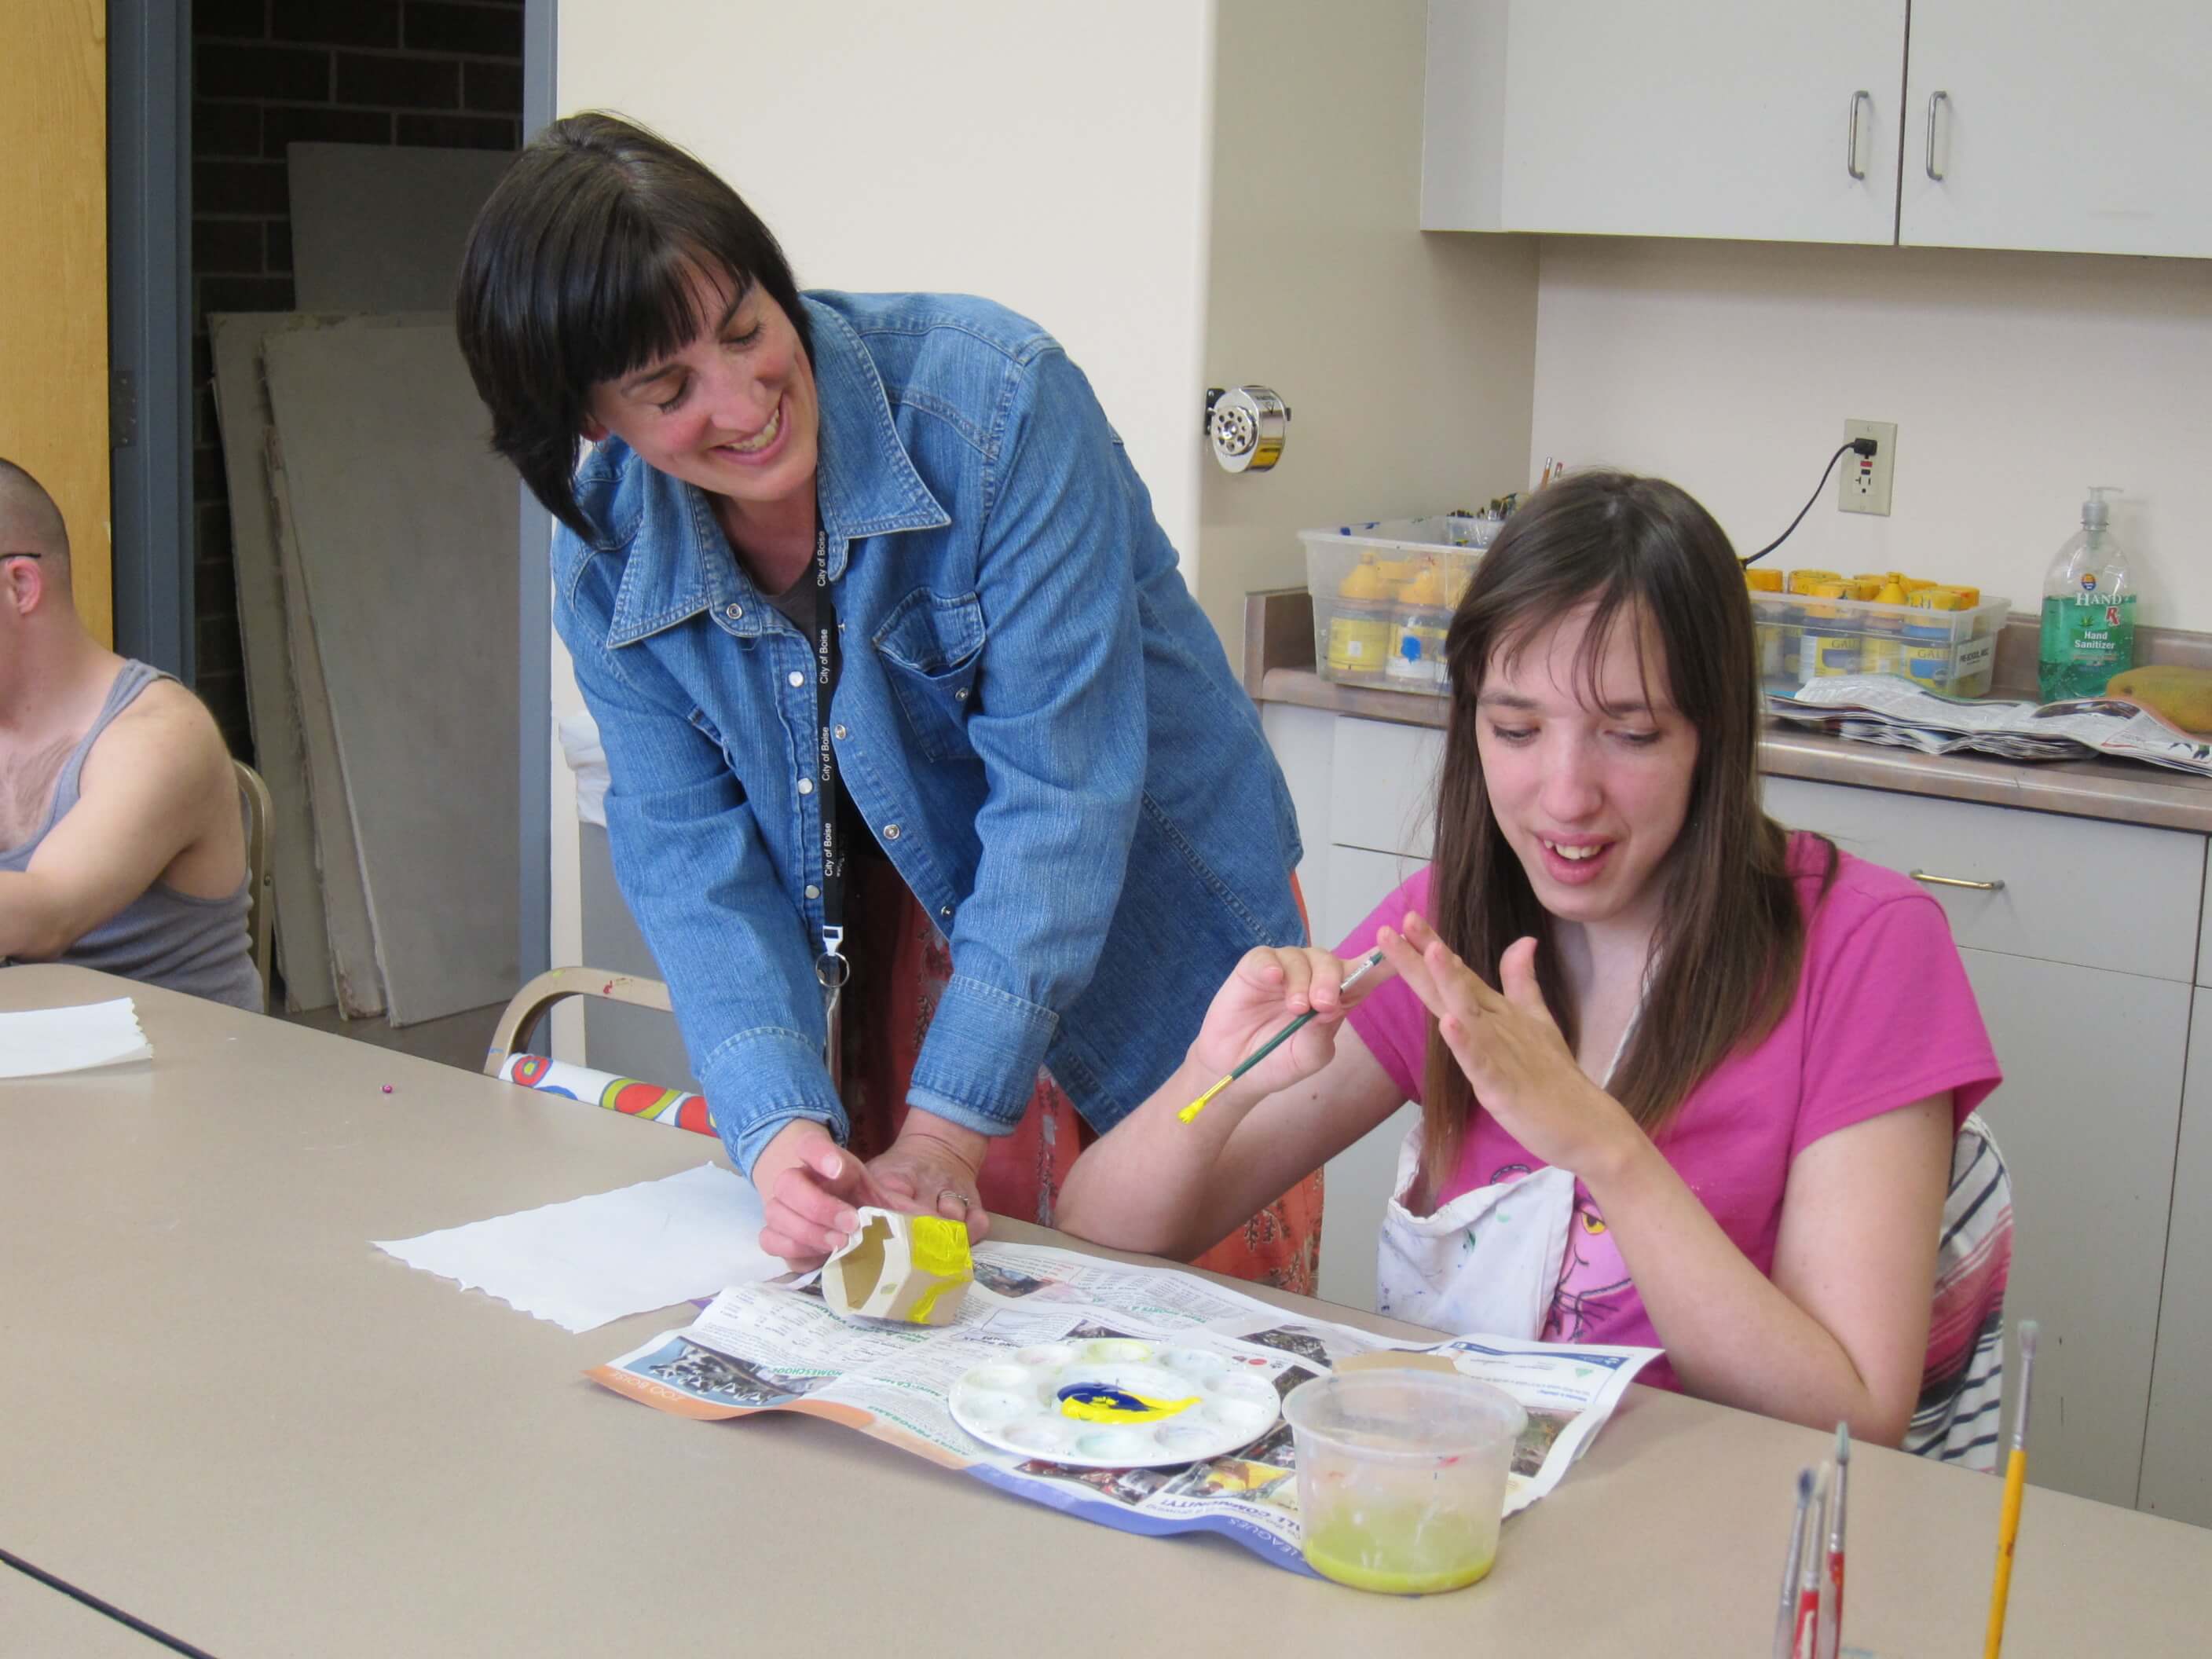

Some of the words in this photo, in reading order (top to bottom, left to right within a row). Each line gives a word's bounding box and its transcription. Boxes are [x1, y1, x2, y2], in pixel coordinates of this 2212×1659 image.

[817, 531, 826, 556] Boise
[817, 558, 826, 567] of
[818, 569, 827, 587] City
[2075, 592, 2122, 606] HAND
[819, 628, 828, 654] Boise
[2084, 631, 2108, 640] Hand
[2075, 639, 2115, 650] Sanitizer
[819, 656, 828, 665] of
[819, 666, 830, 684] City
[821, 727, 830, 751] Boise
[822, 753, 830, 762] of
[822, 764, 832, 781] City
[823, 822, 832, 847] Boise
[824, 849, 833, 858] of
[824, 859, 834, 877] City
[1226, 1518, 1298, 1556] LEAGUES
